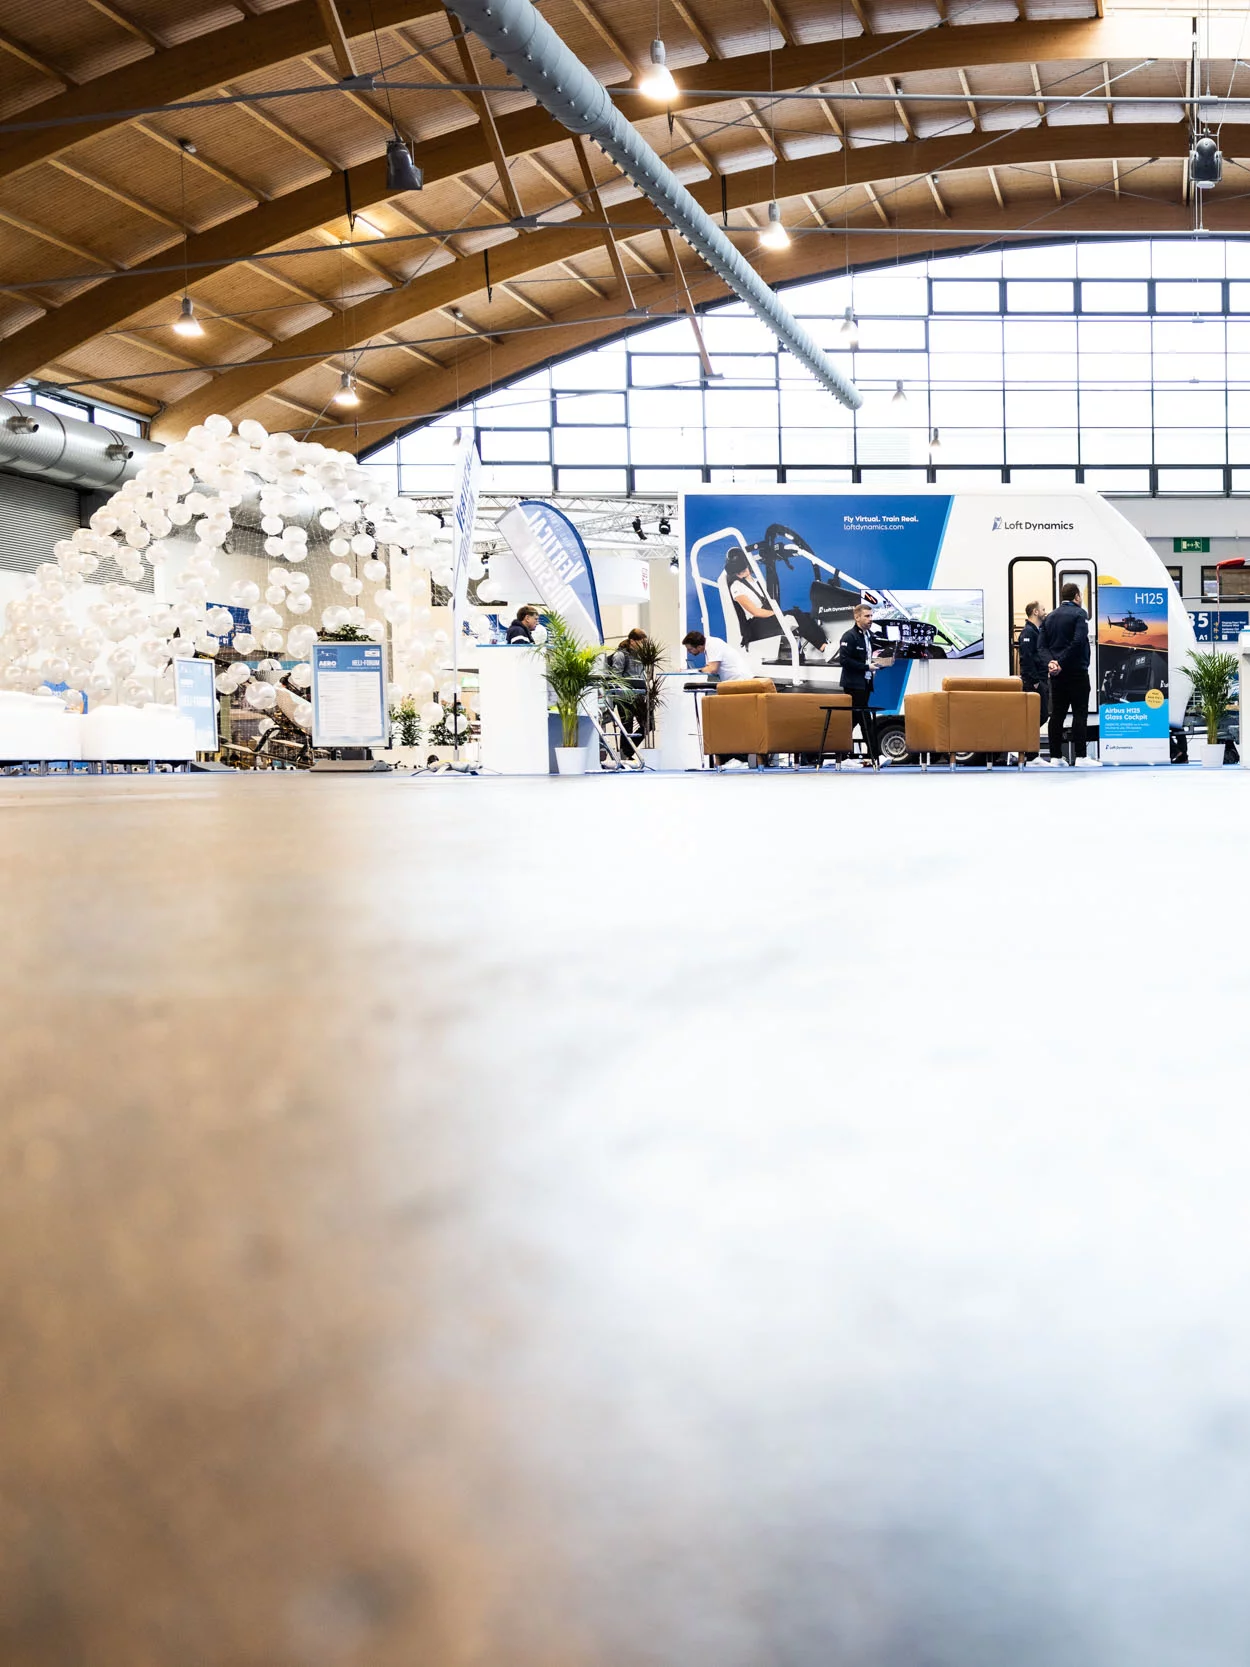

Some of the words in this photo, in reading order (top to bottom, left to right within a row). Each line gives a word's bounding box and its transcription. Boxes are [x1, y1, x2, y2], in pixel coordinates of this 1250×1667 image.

[843, 515, 854, 524] Fly
[855, 515, 881, 523] Virtual.
[881, 515, 900, 523] Train
[901, 515, 919, 523] Real.
[1004, 520, 1024, 530] Loft
[1025, 520, 1074, 531] Dynamics
[1134, 592, 1164, 605] H125
